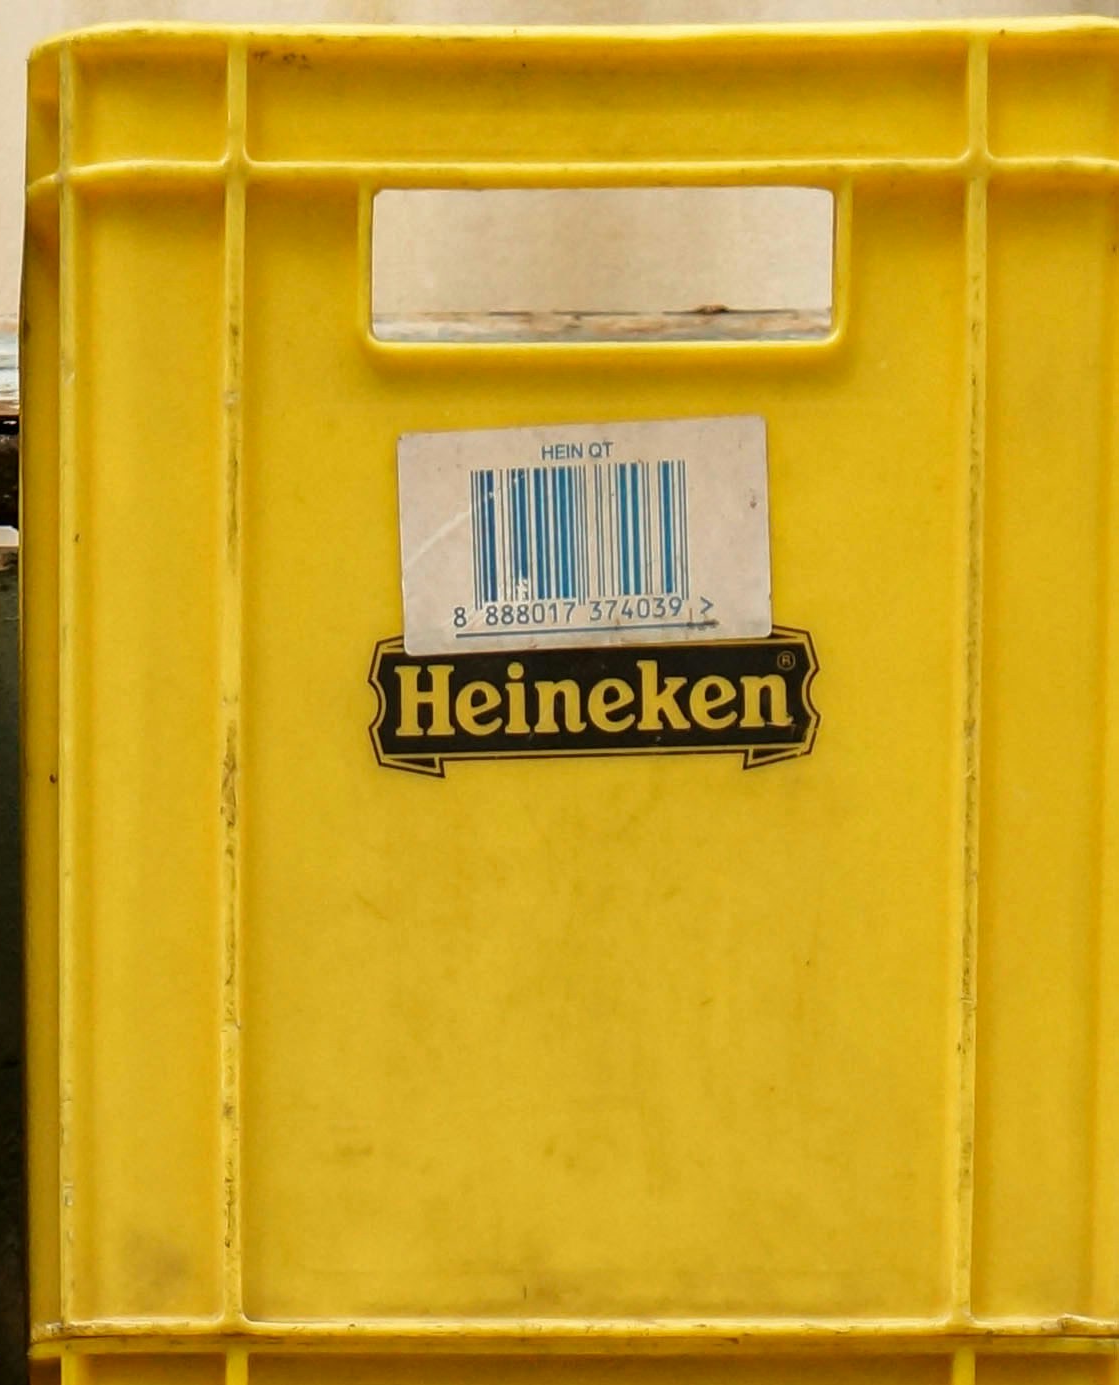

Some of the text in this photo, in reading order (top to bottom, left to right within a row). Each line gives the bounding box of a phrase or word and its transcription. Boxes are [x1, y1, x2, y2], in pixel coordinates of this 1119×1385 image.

[541, 441, 615, 461] HEIN QT
[453, 605, 468, 628] 8
[484, 602, 576, 627] 888017
[588, 596, 682, 622] 374039
